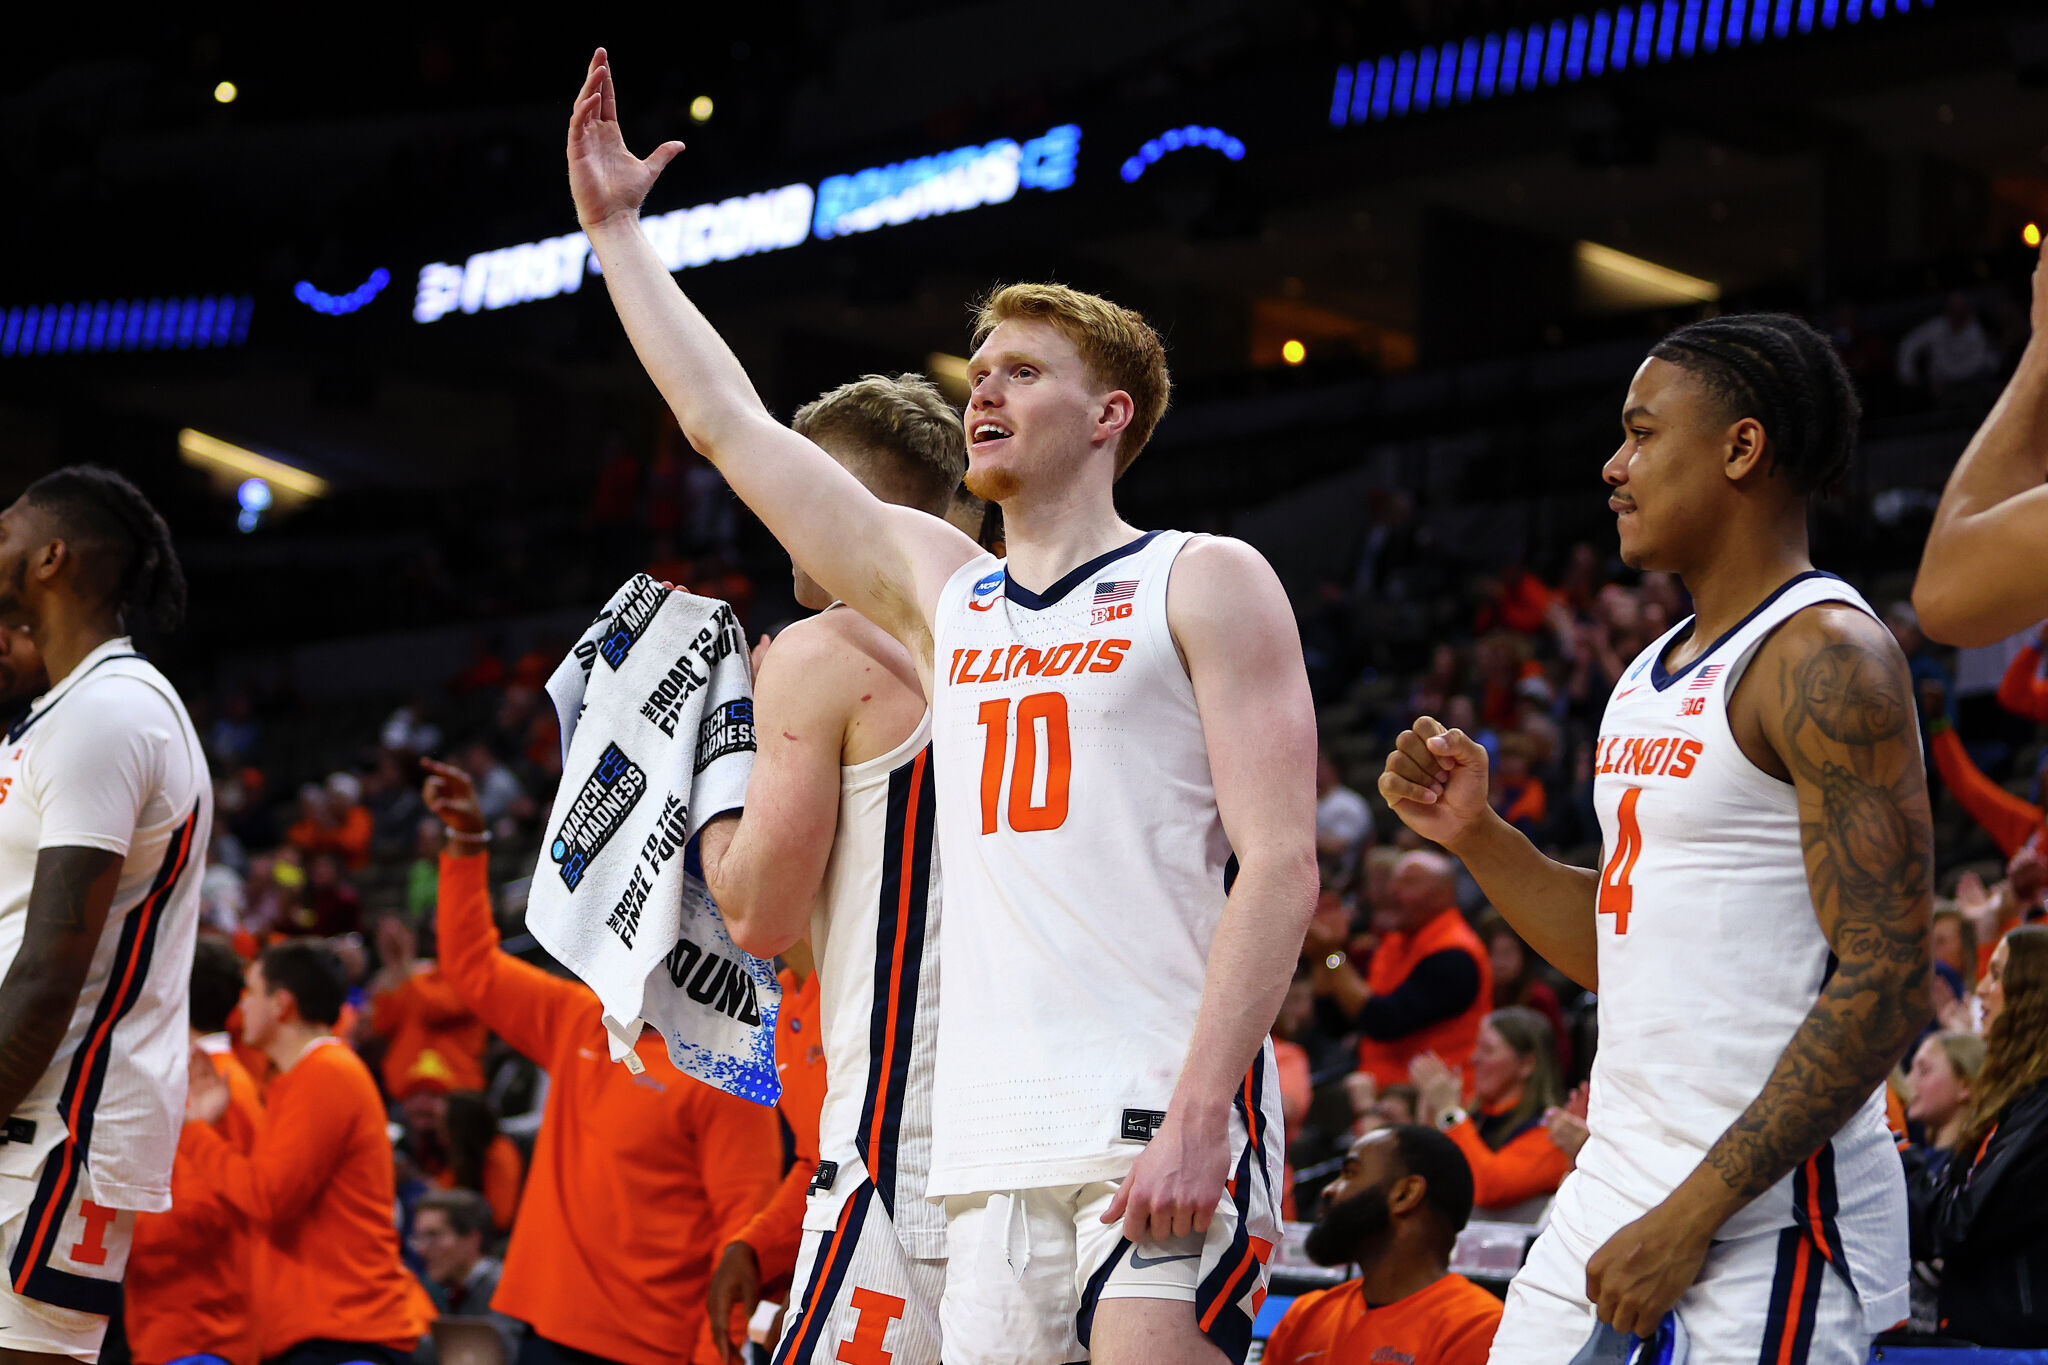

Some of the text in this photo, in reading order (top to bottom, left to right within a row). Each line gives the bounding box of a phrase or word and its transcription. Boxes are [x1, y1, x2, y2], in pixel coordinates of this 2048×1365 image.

[620, 580, 664, 633] MADN
[688, 627, 713, 652] TO
[949, 638, 1132, 687] ILLINOIS
[639, 701, 661, 725] THE
[647, 655, 693, 713] ROAD
[701, 706, 727, 741] RCH
[977, 691, 1072, 835] 10
[1594, 737, 1704, 779] LLINOIS
[560, 776, 607, 847] MARCH
[576, 765, 643, 852] MADNESS
[605, 913, 622, 935] THE
[614, 863, 643, 922] ROAD
[640, 832, 659, 862] TO
[1598, 787, 1642, 935] 4
[619, 877, 653, 951] FINAL
[663, 938, 761, 1027] OUND
